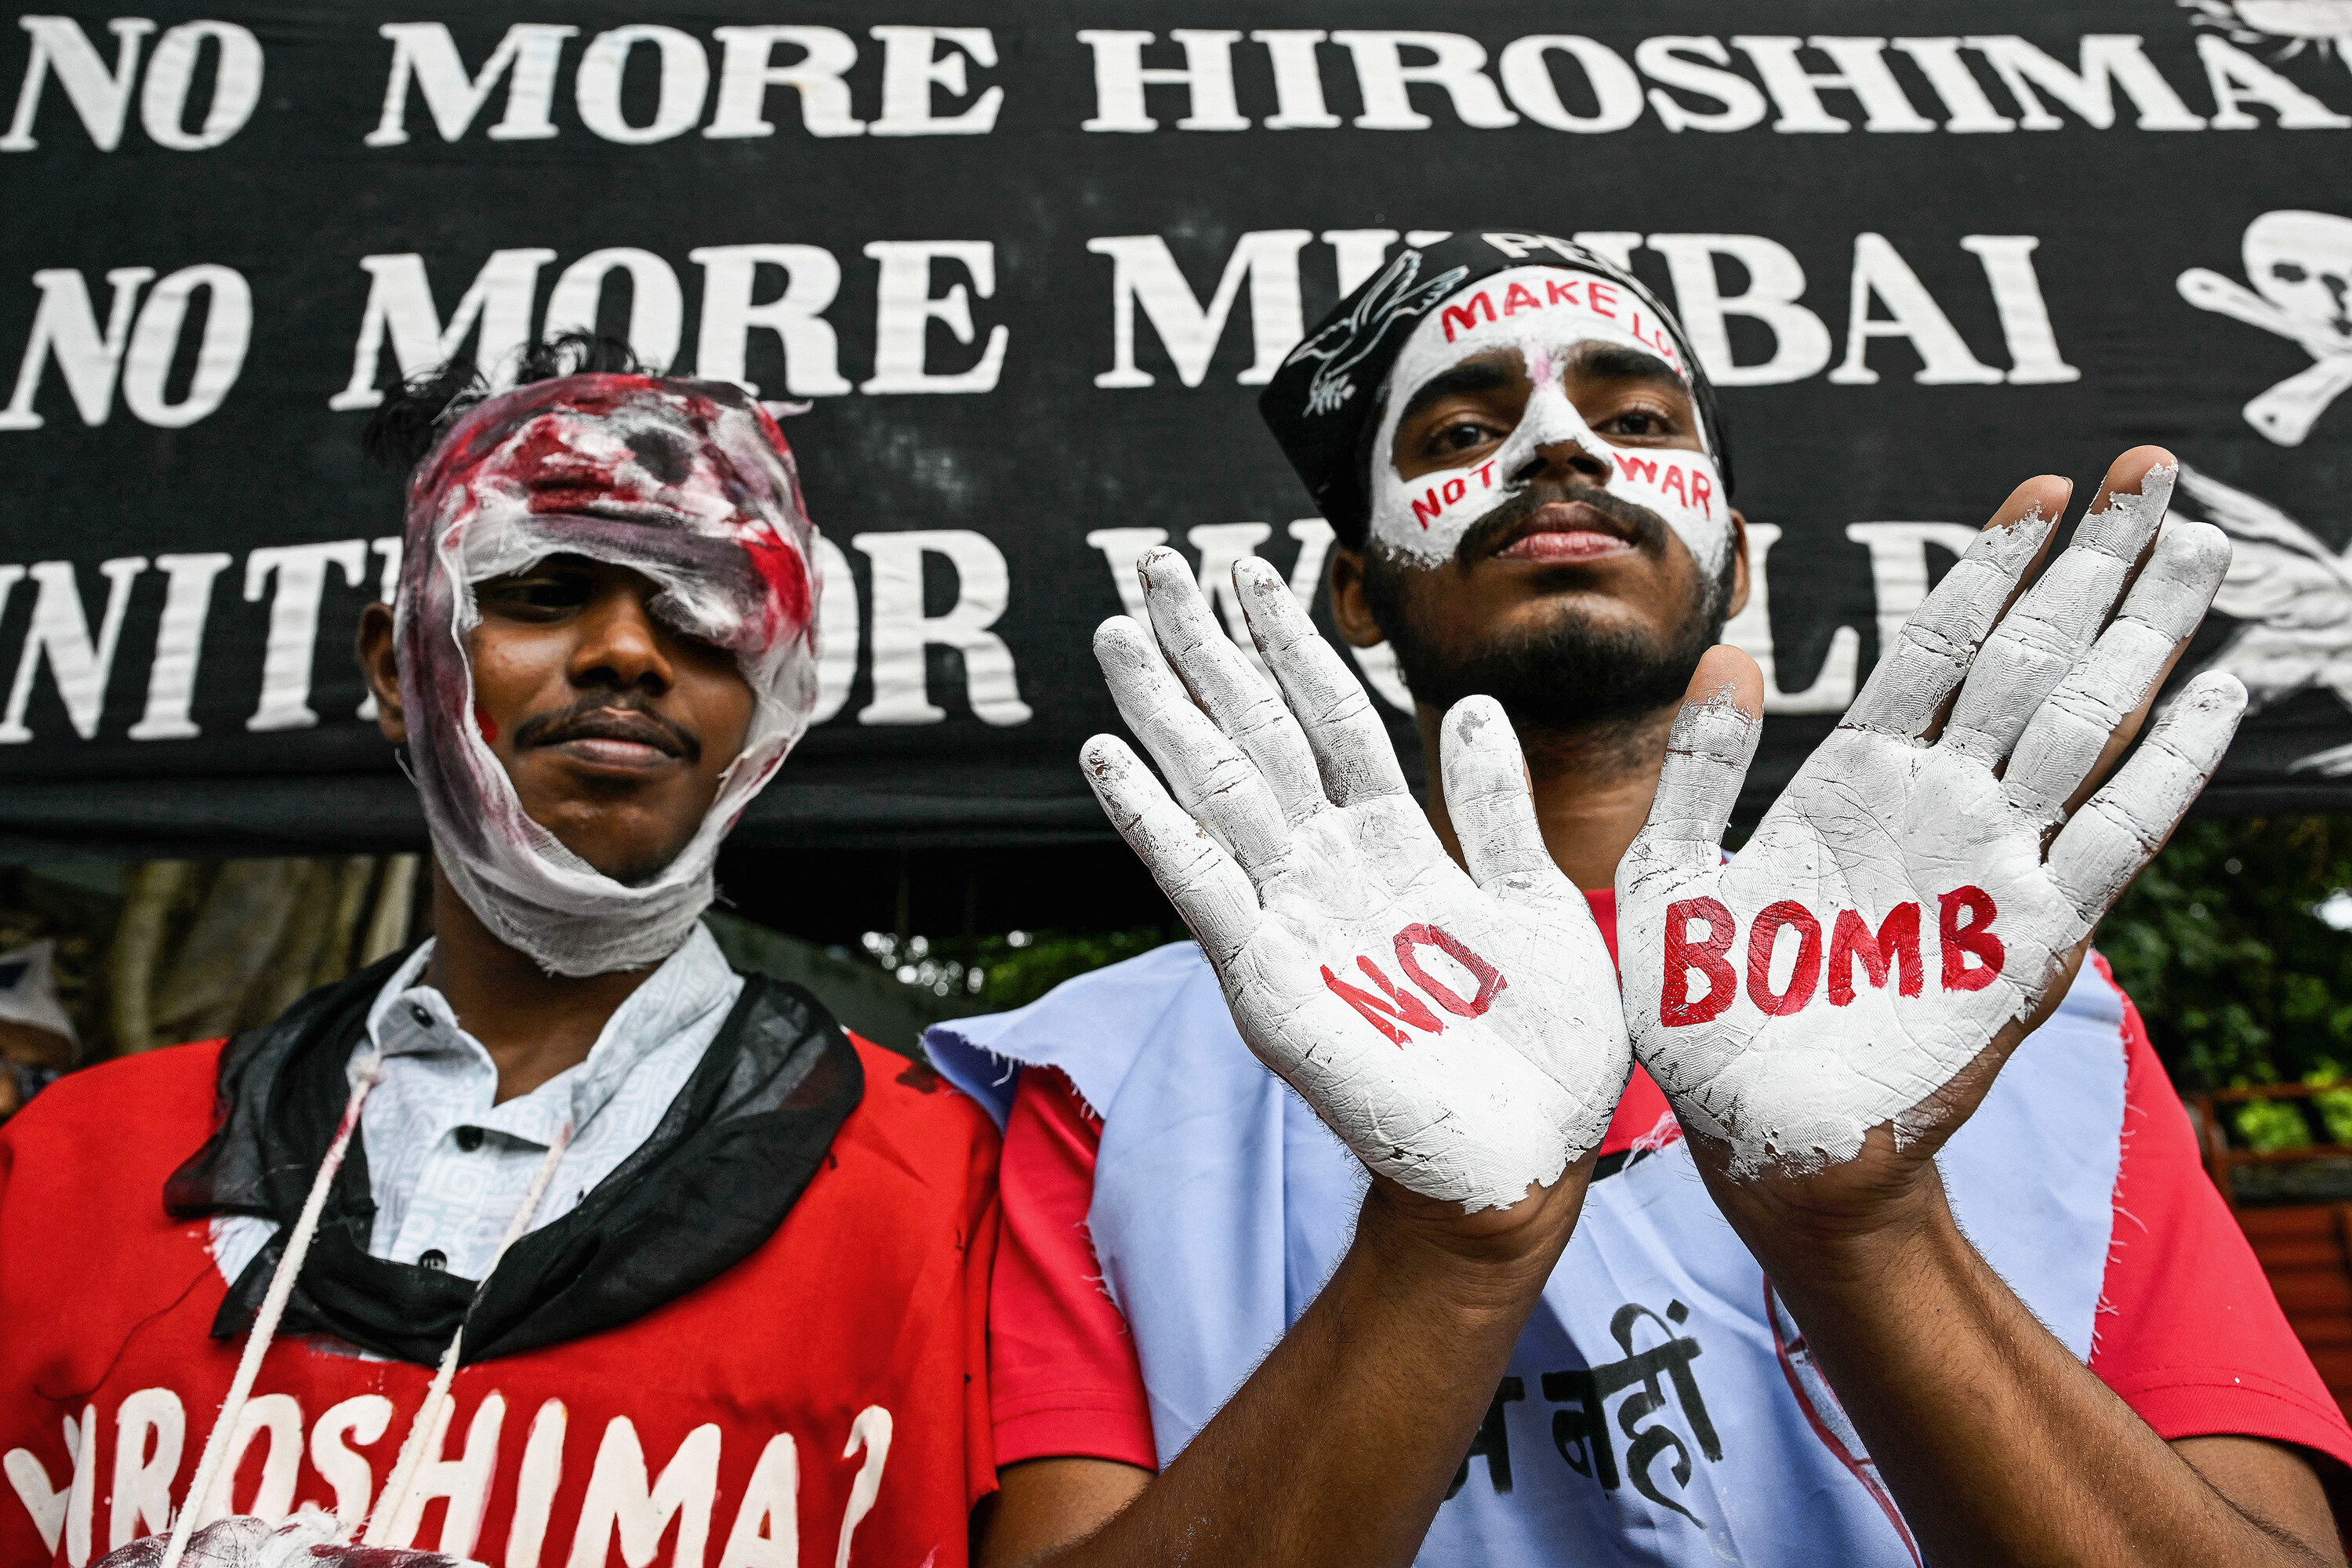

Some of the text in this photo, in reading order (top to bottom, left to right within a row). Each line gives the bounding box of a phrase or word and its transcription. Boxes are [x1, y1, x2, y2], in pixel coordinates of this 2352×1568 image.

[0, 15, 2352, 151] NO MORE HIROSHIMA
[0, 229, 2082, 430] NO MORE MBAI
[1442, 280, 1618, 343] MAKE
[1411, 451, 1712, 531] NOT WAR
[0, 536, 403, 745] NIT
[1319, 885, 2005, 1049] NO BOMB
[1541, 1299, 1723, 1530] नहीं
